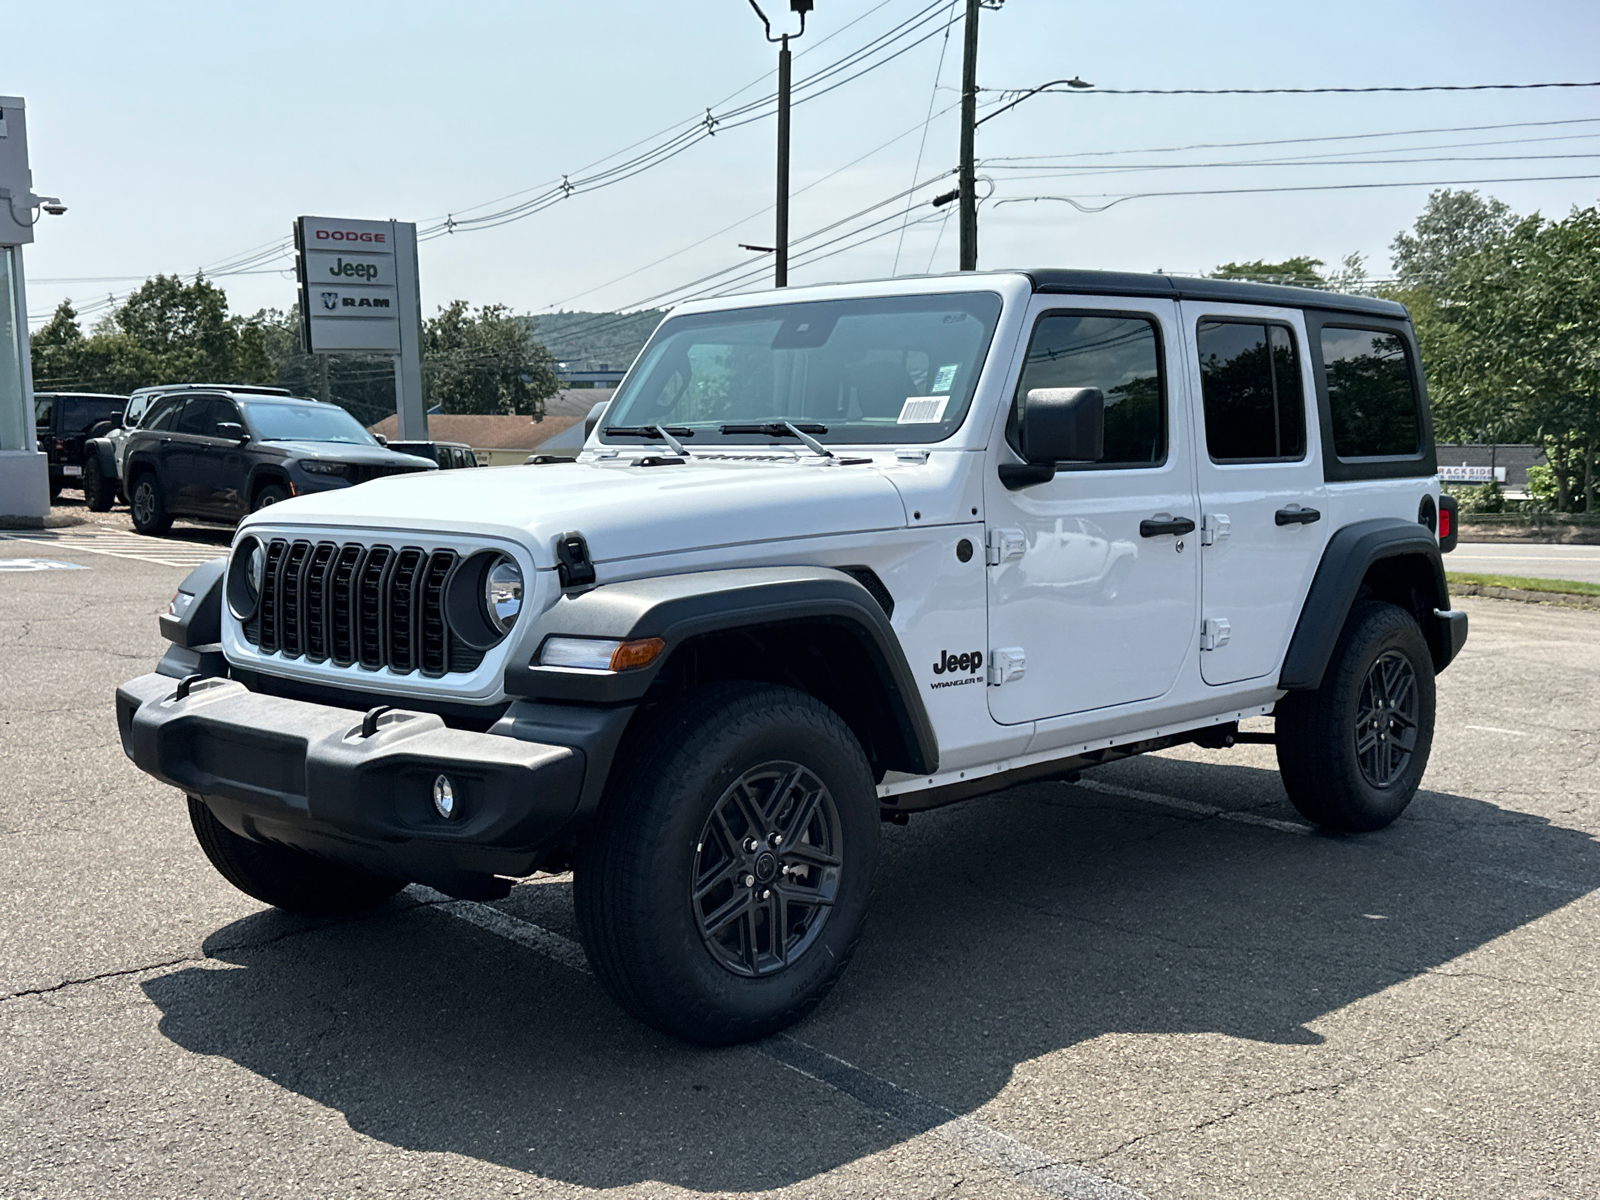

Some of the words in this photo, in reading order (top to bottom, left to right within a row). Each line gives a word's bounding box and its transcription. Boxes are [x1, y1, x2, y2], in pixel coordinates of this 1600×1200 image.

[315, 230, 386, 243] DODGE
[329, 257, 378, 281] Jeep
[342, 297, 390, 308] RAM
[933, 650, 983, 674] Jeep
[930, 677, 976, 689] WRANGLER
